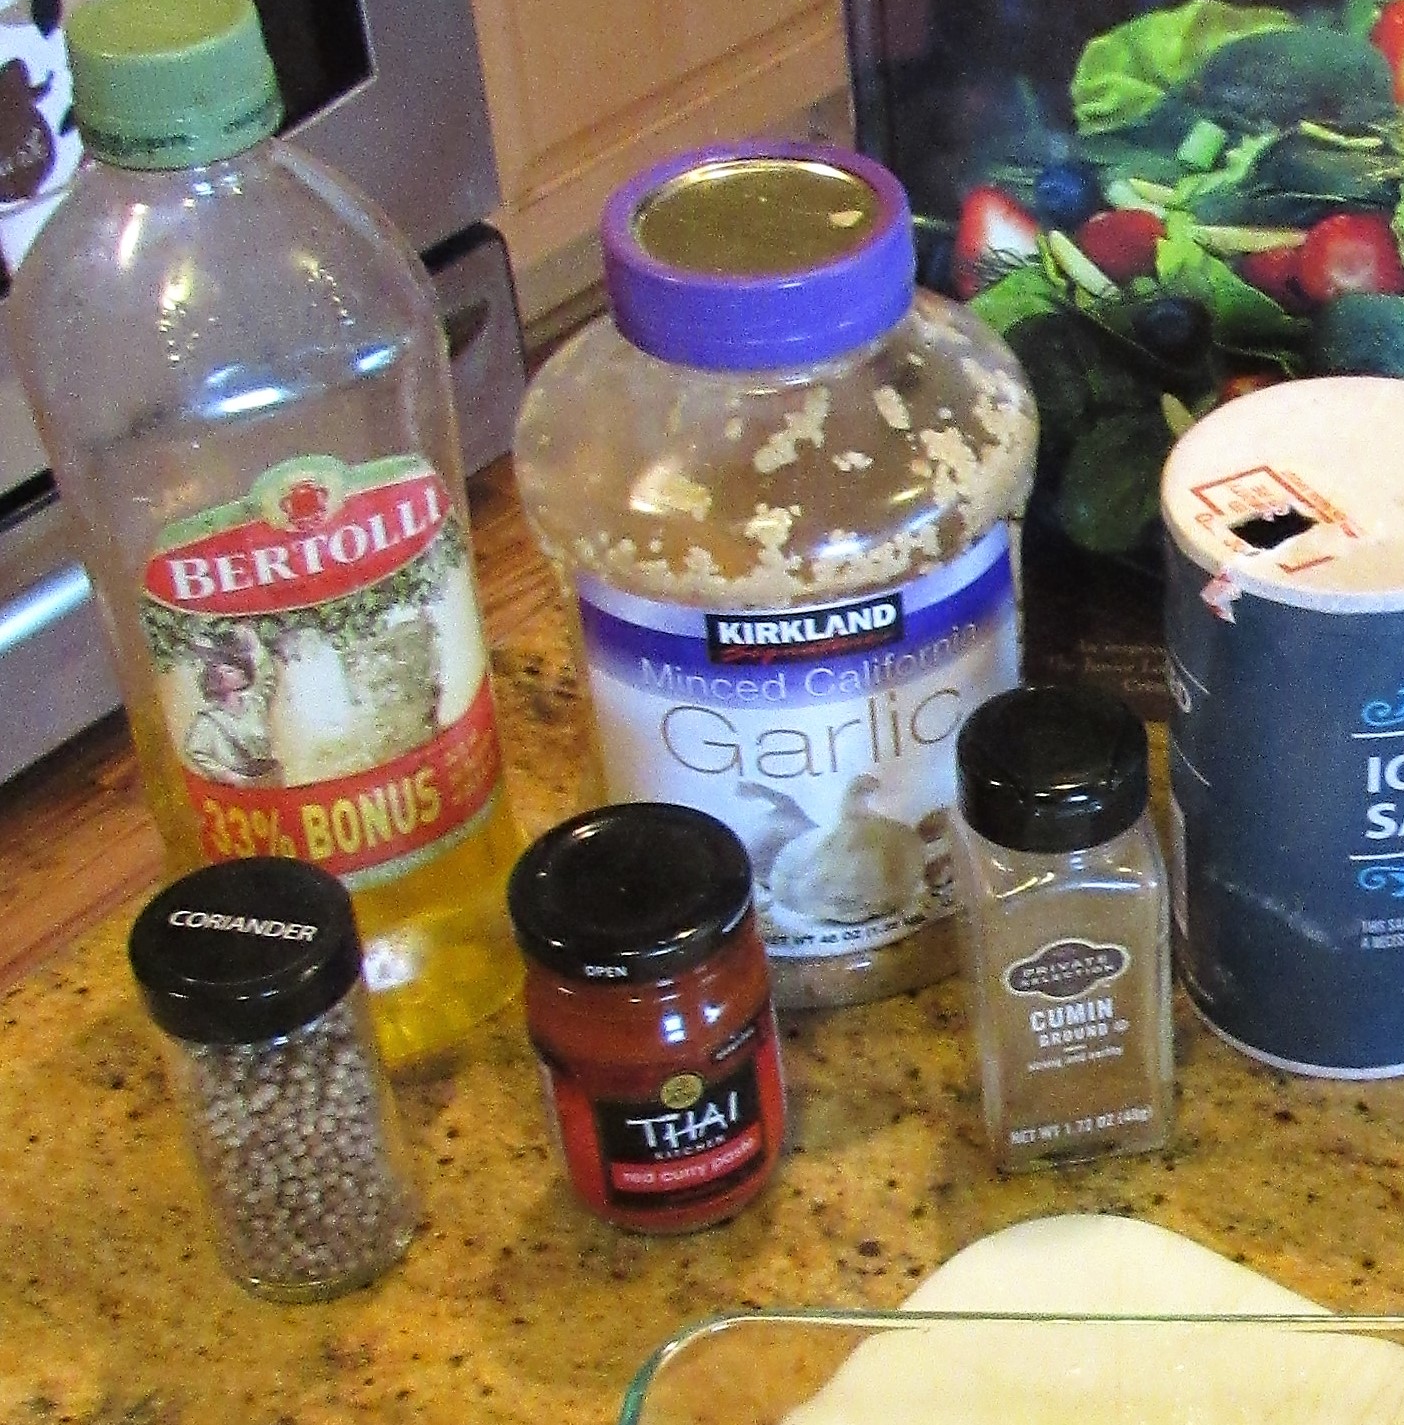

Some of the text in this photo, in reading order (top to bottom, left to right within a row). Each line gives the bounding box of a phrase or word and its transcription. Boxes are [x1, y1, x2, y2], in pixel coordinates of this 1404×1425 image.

[170, 484, 443, 601] BERTOLLI
[717, 602, 897, 646] KIRKLAND
[640, 656, 786, 702] Minced
[804, 621, 980, 697] California
[661, 687, 962, 779] Garlic
[301, 766, 441, 860] BONUS
[168, 907, 319, 943] CORIANDER
[584, 964, 629, 978] OPEN
[1022, 954, 1108, 978] PRIVATE
[1029, 997, 1114, 1032] CUMIN
[1038, 1022, 1109, 1048] GROUND
[625, 1090, 738, 1149] THAI
